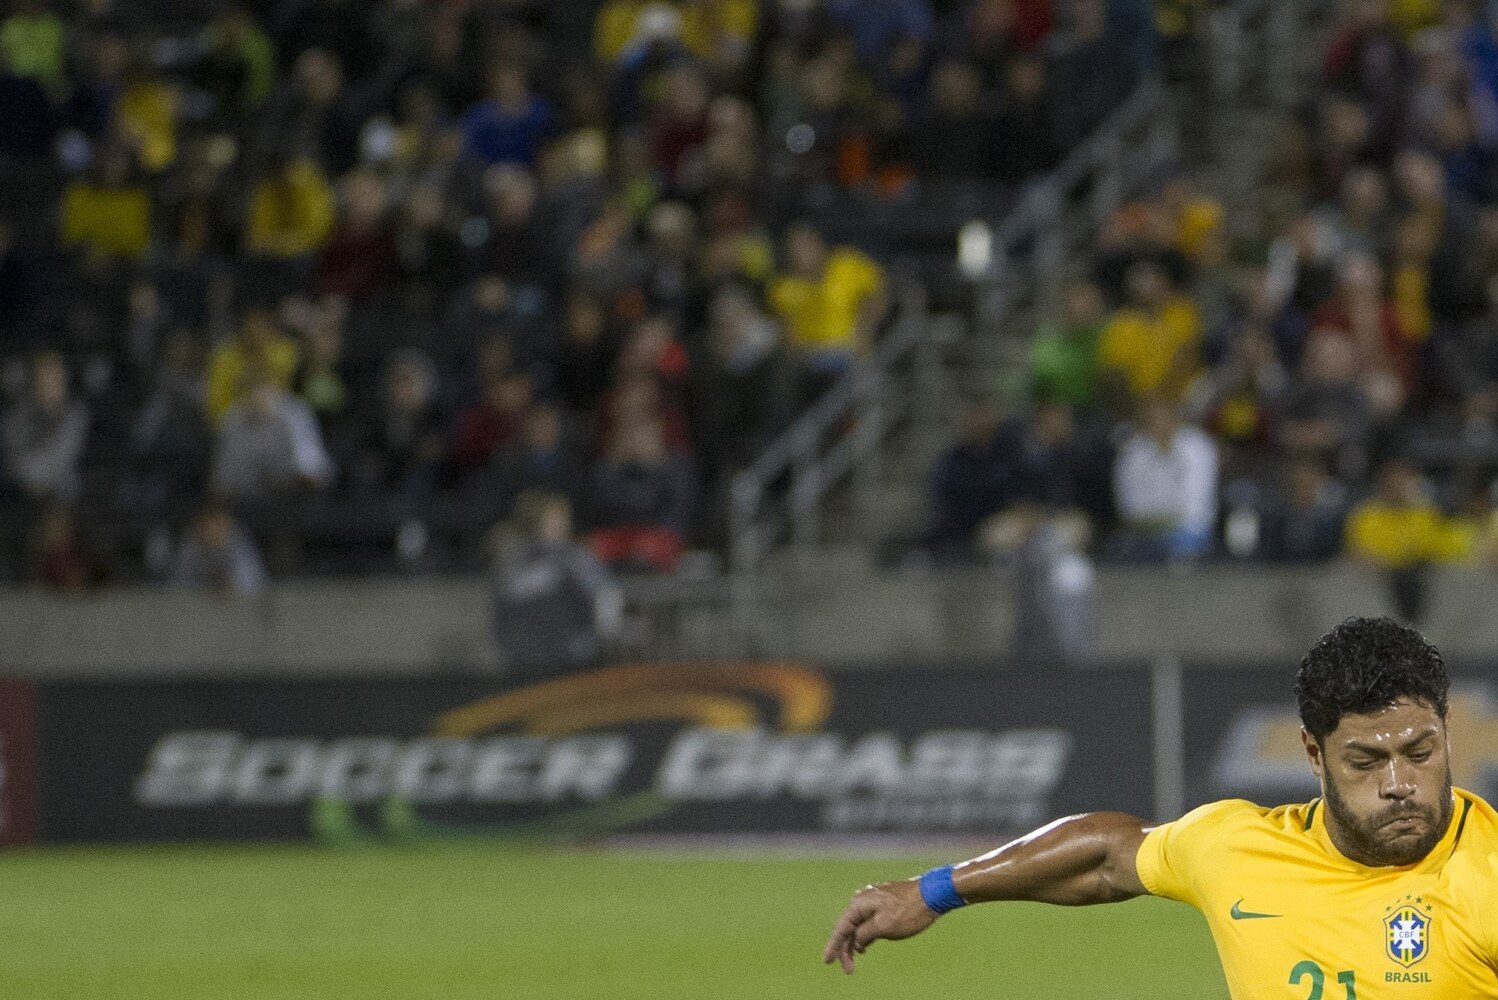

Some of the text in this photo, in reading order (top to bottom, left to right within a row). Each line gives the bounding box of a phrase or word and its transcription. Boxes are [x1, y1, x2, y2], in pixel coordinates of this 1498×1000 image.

[135, 725, 1072, 802] SOCCER GRASS
[1385, 971, 1432, 982] BRASIL
